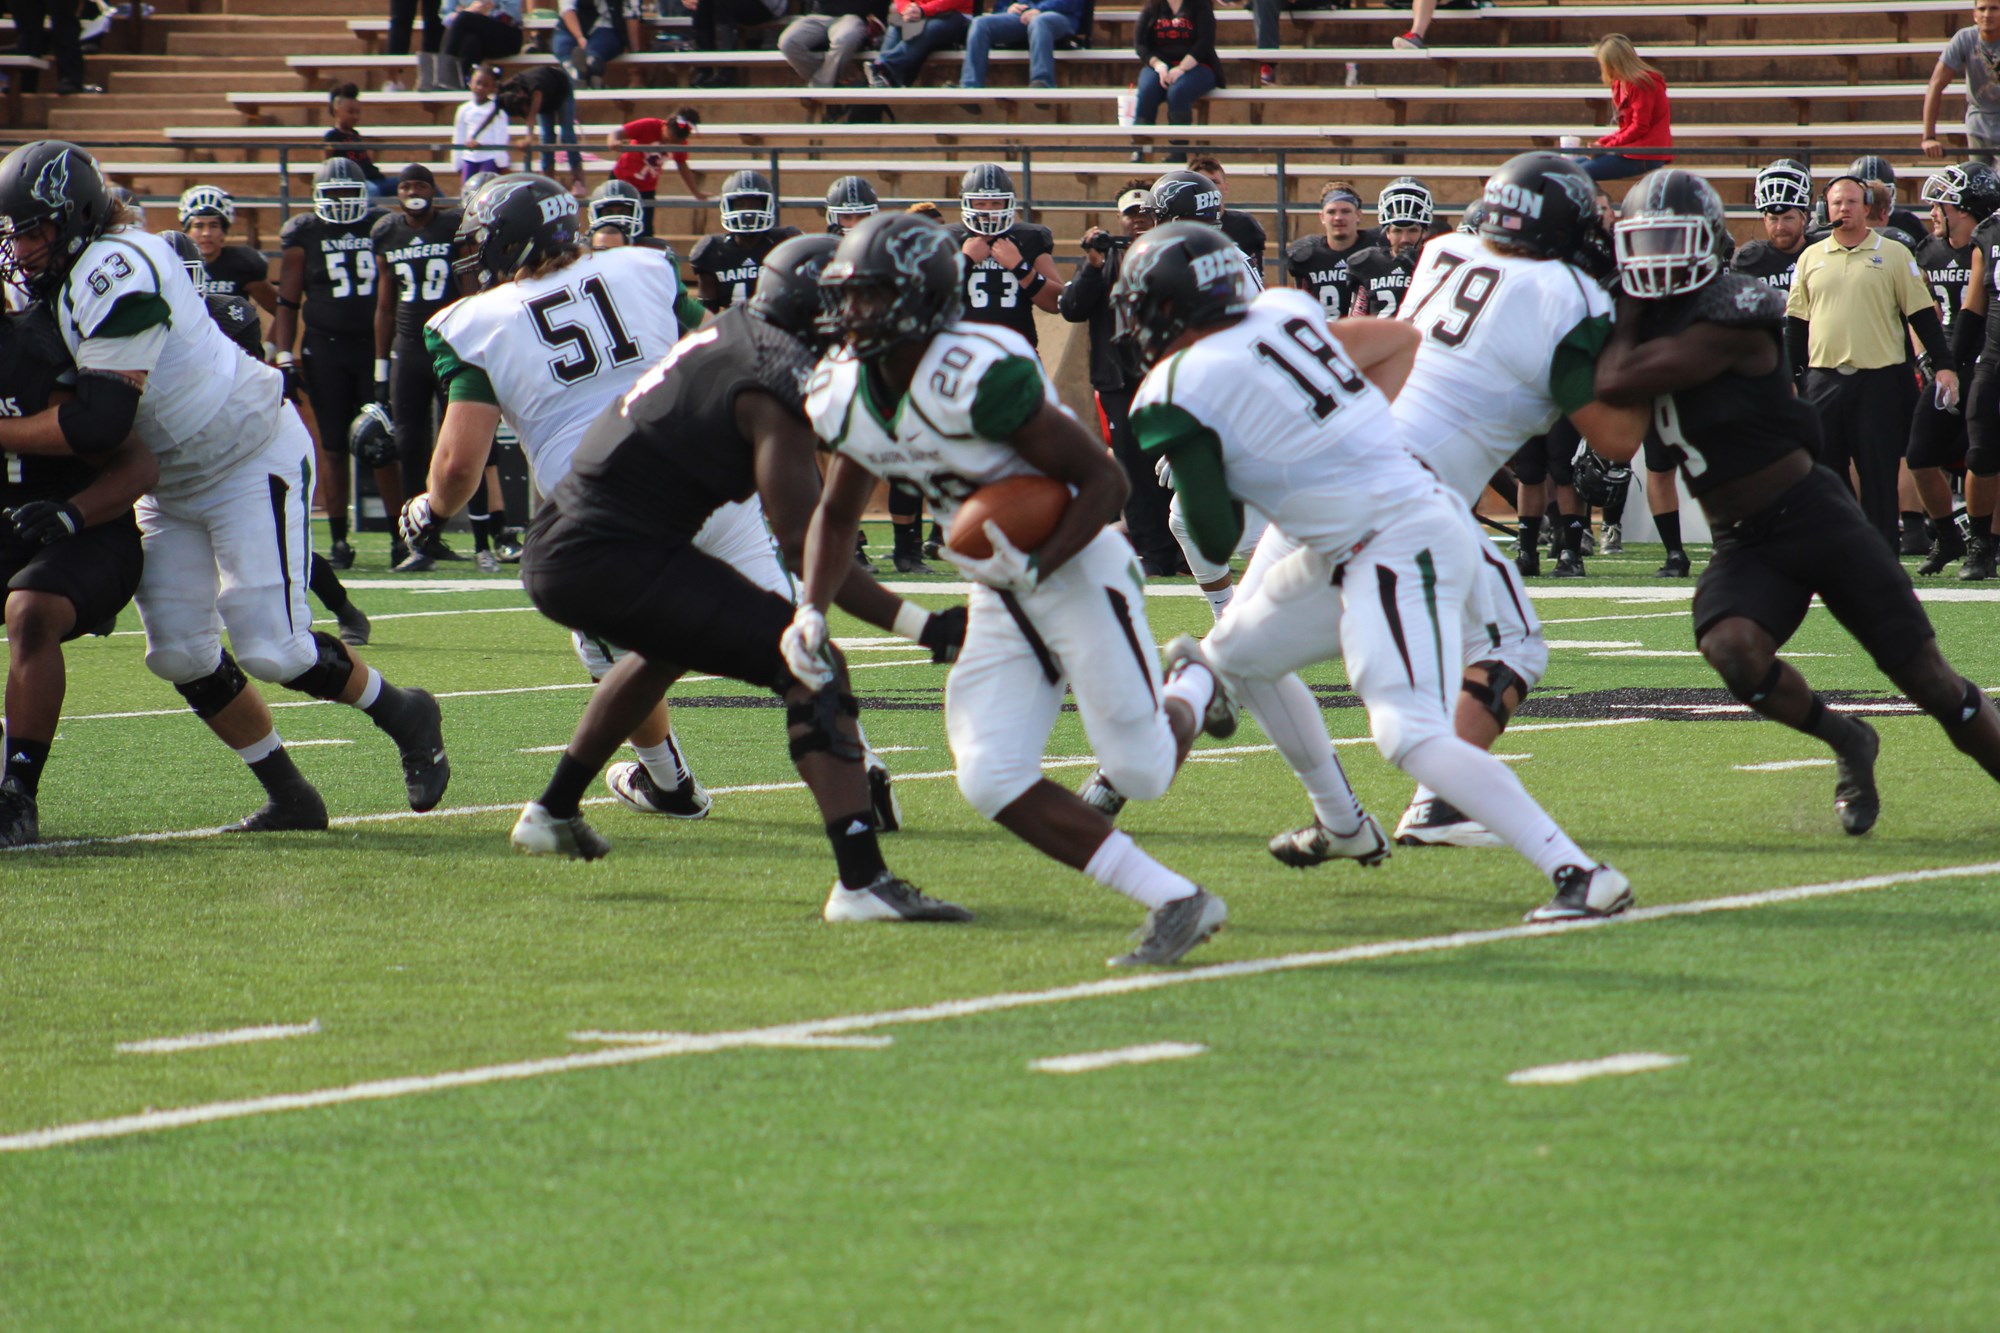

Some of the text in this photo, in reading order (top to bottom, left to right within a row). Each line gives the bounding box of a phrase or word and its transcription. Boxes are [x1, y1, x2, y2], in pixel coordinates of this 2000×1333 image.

[86, 251, 136, 298] 63
[325, 250, 376, 298] 59
[385, 243, 451, 263] RANGERS
[967, 271, 1019, 308] 63
[1403, 247, 1505, 352] 79
[521, 271, 645, 388] 51
[929, 346, 974, 399] 20
[1247, 314, 1371, 428] 18
